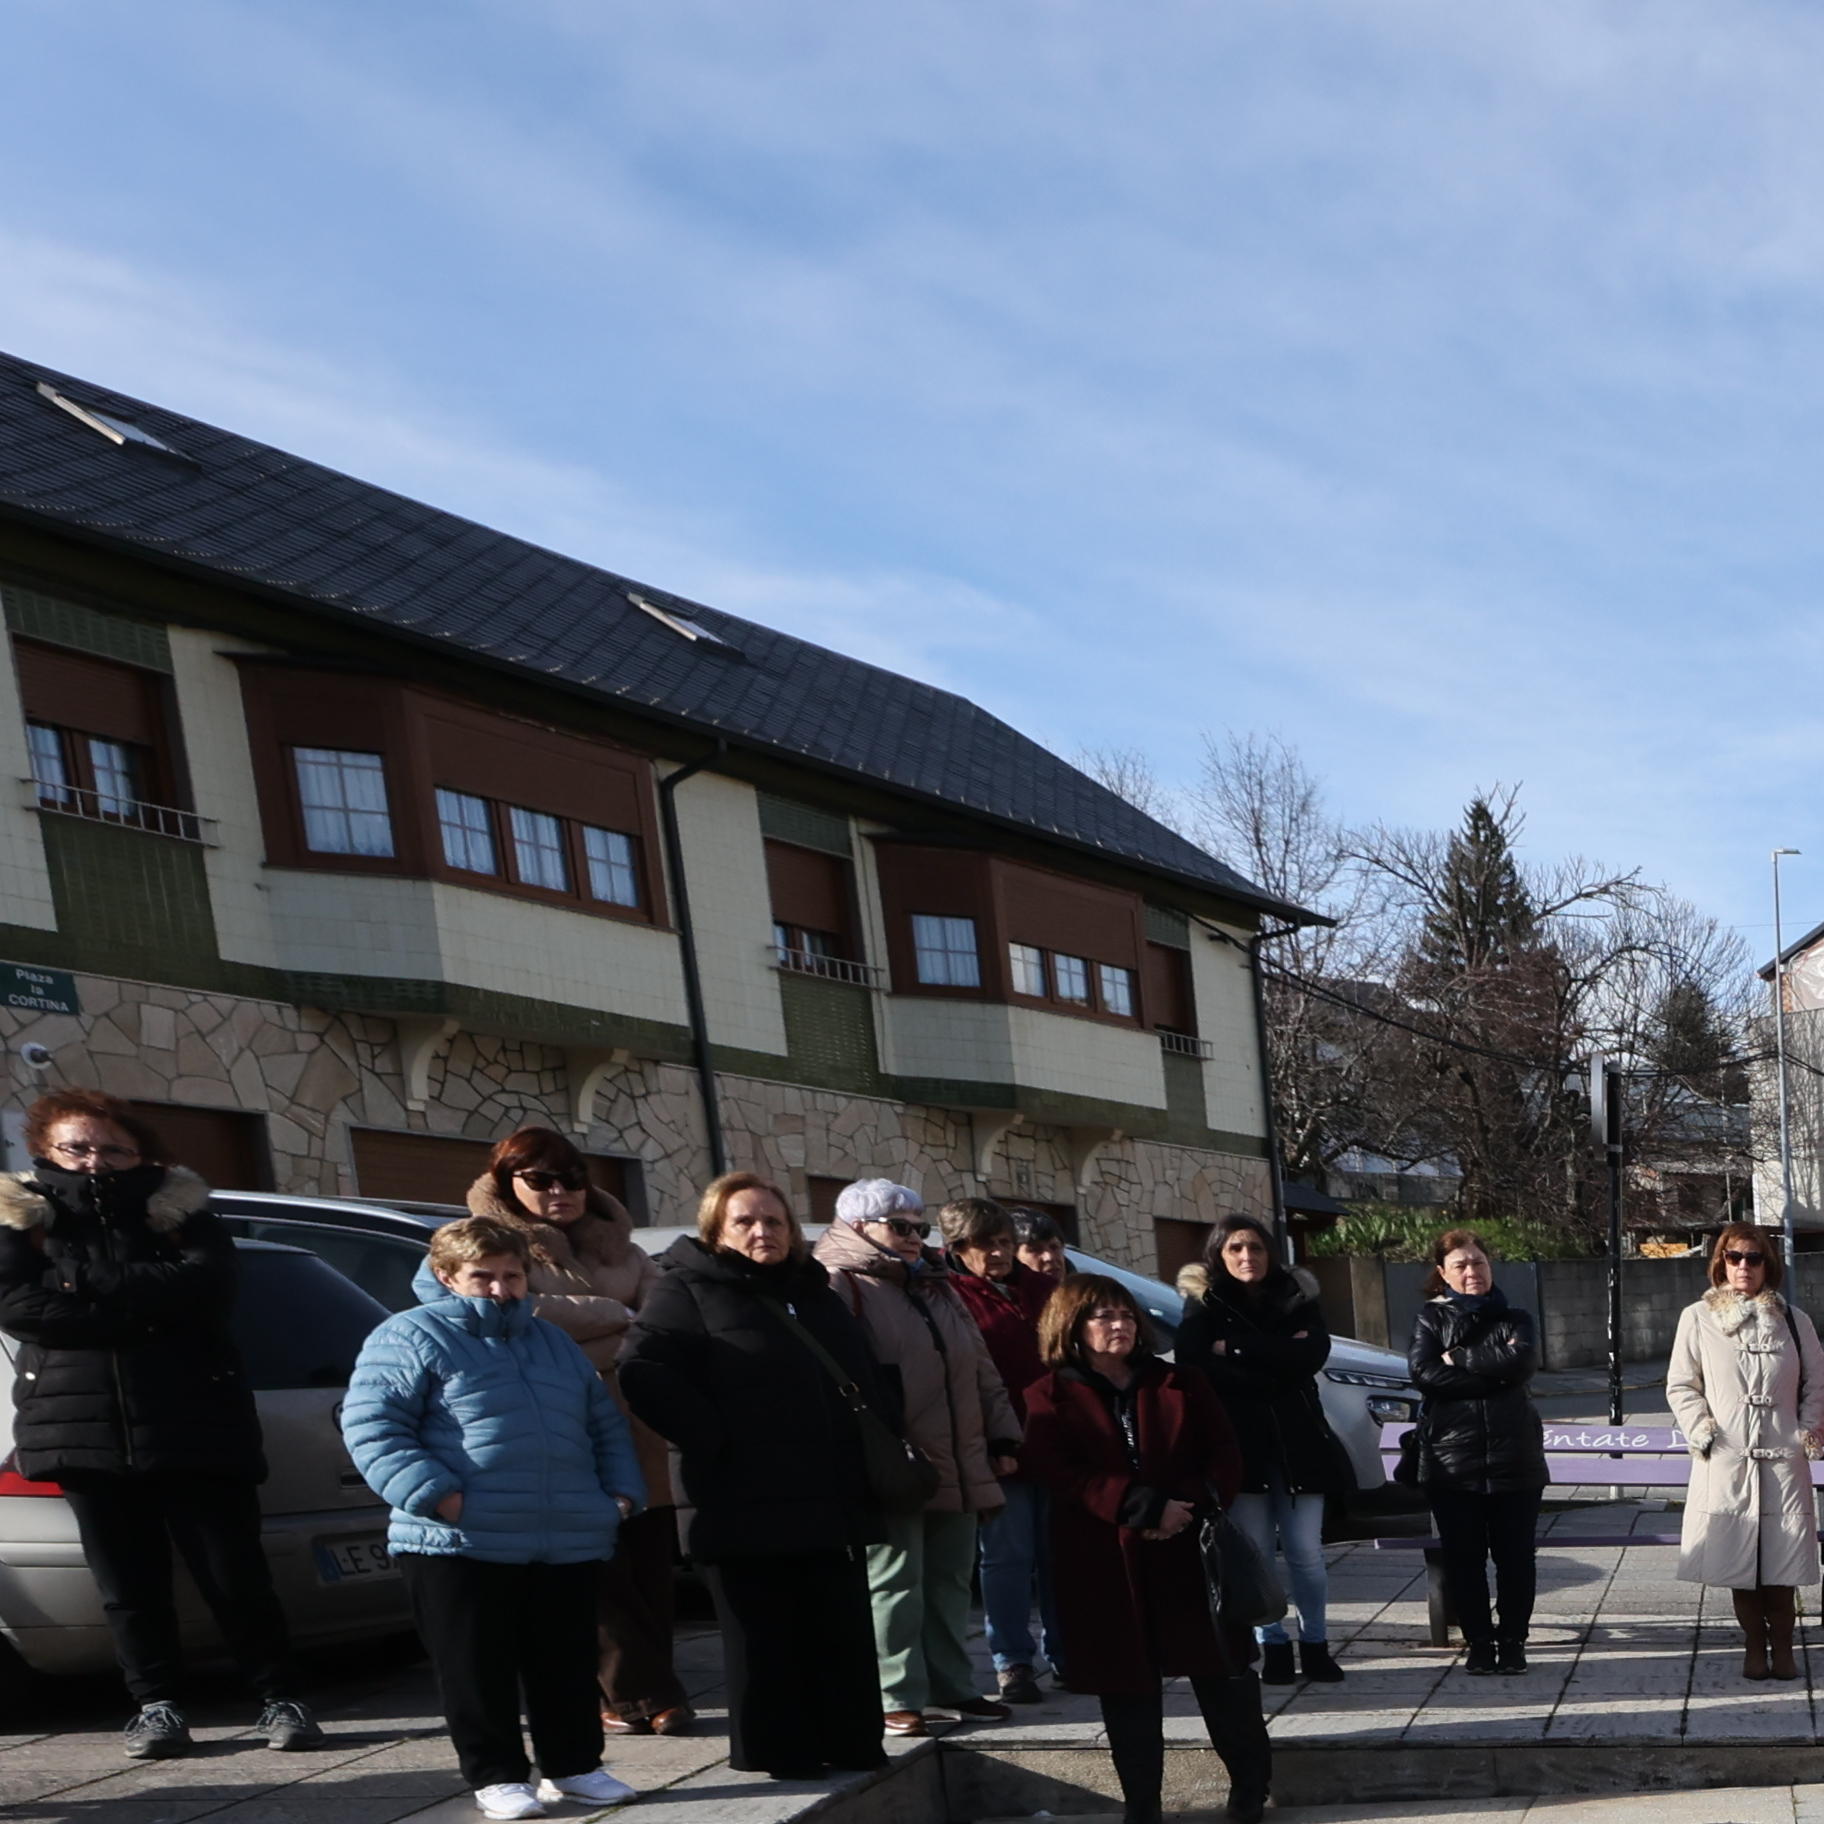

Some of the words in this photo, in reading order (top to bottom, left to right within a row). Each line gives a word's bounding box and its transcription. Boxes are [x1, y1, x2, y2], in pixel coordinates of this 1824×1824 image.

[16, 968, 54, 984] Plaza
[31, 984, 45, 995] la
[8, 994, 70, 1011] CORTINA
[1543, 1429, 1650, 1448] éntate
